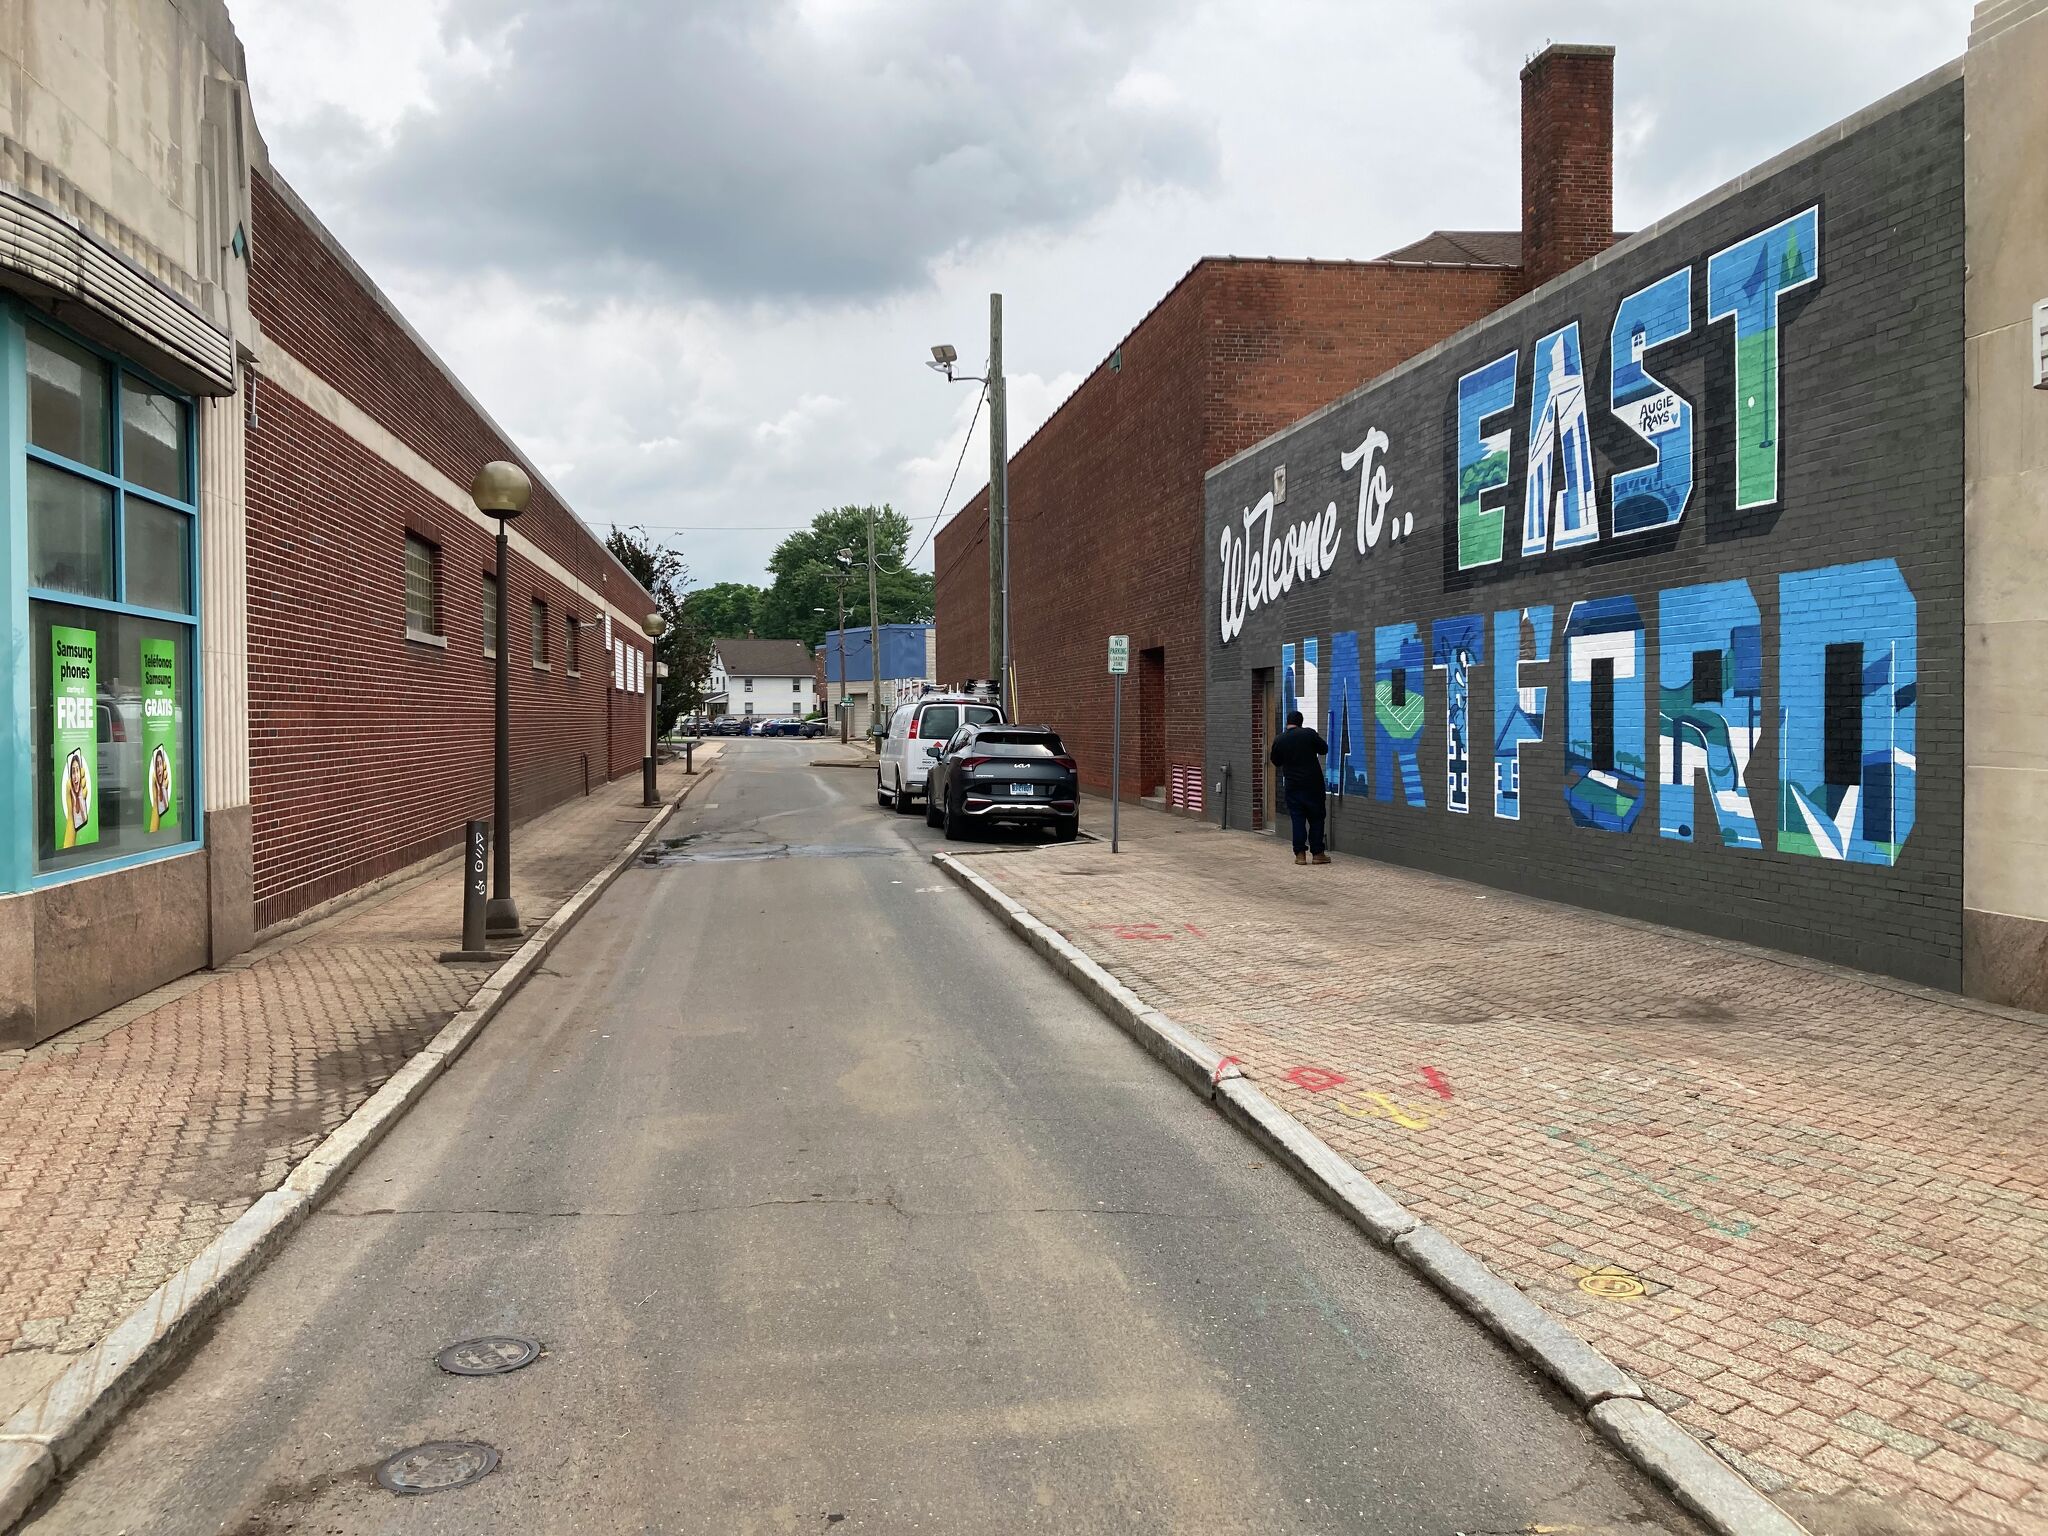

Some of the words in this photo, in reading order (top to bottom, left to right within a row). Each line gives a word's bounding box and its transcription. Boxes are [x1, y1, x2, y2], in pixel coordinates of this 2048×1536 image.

[1458, 204, 1819, 572] EAST
[1640, 395, 1674, 419] AUGIE
[1220, 491, 1342, 643] Welcome
[56, 639, 93, 664] Samsung
[60, 661, 90, 682] phones
[145, 671, 171, 688] Samsung
[57, 696, 94, 729] FREE
[145, 698, 173, 717] GRATIS
[1282, 557, 1917, 867] HARTFORD
